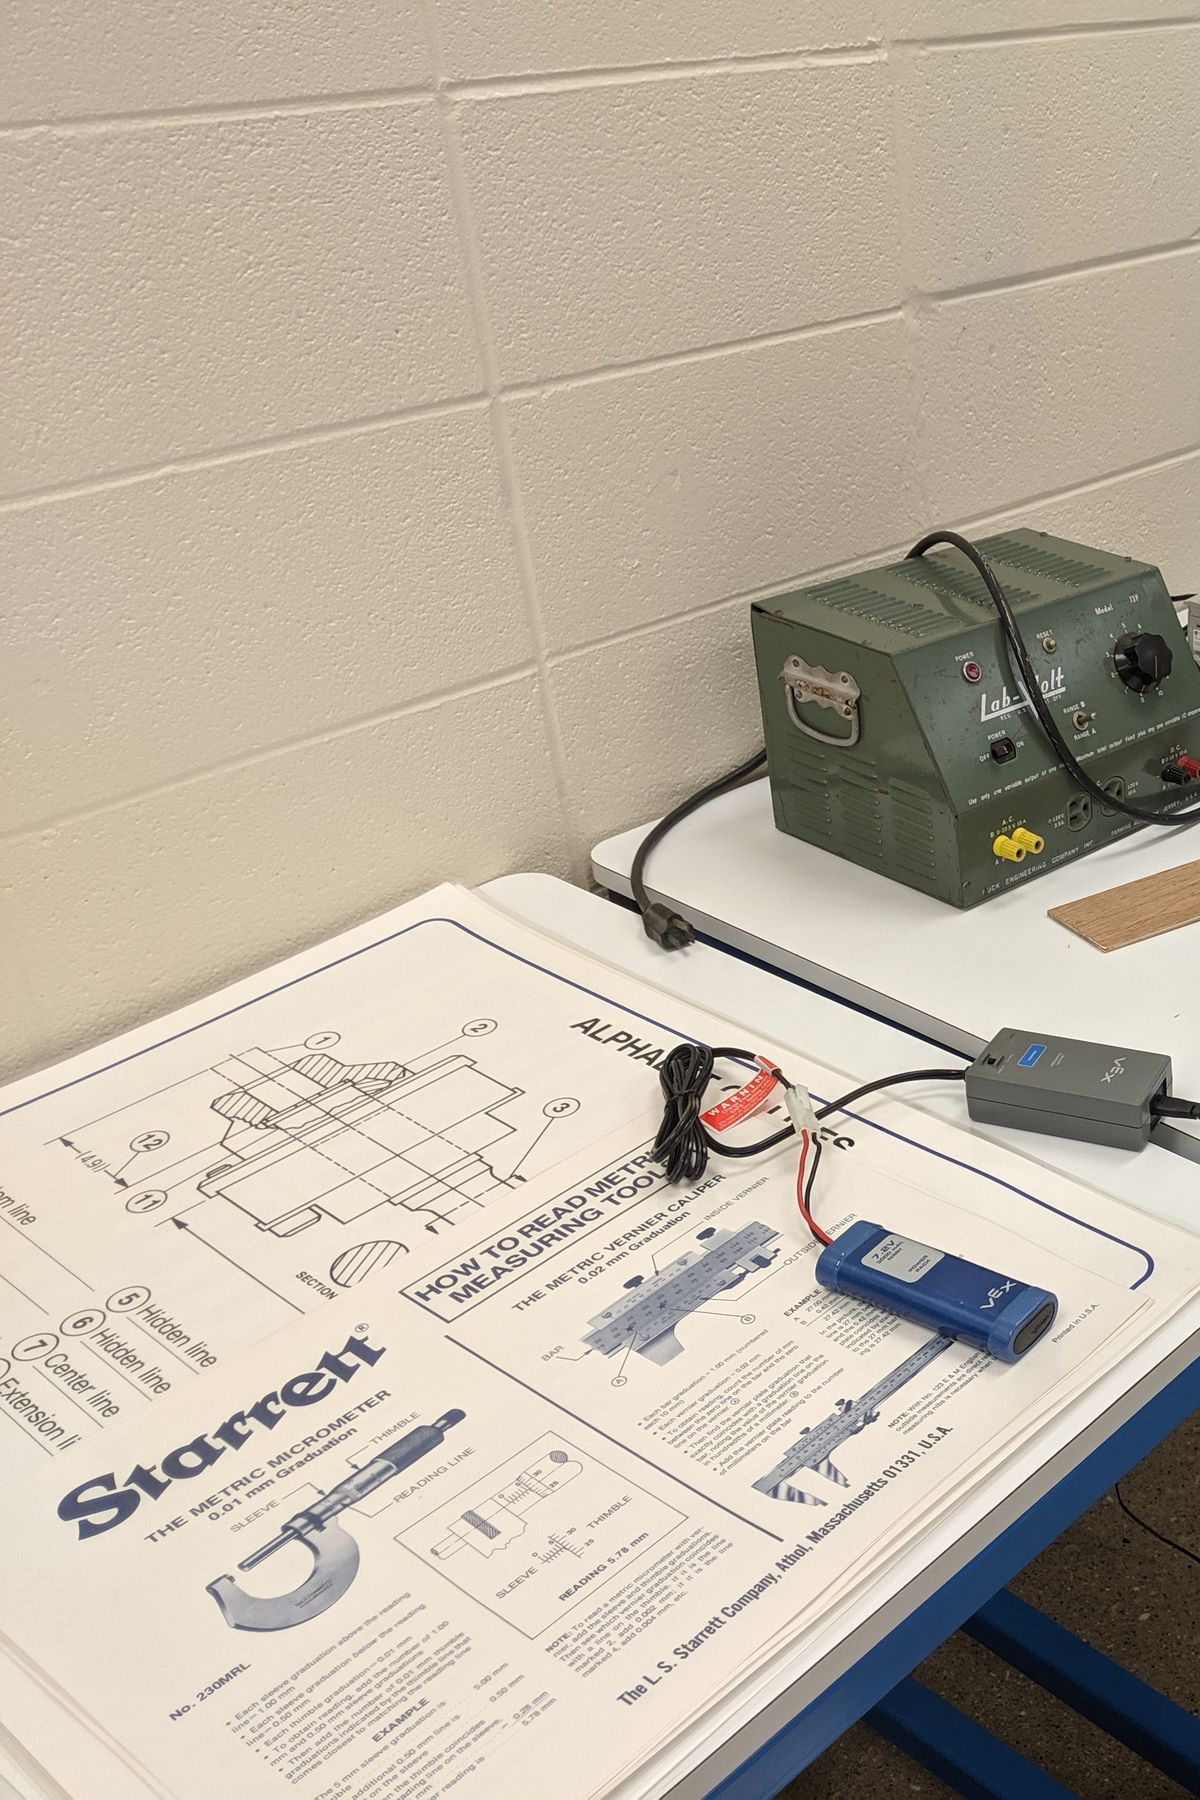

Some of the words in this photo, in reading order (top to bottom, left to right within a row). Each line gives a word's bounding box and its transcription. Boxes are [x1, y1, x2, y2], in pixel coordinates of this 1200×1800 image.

[1094, 603, 1113, 614] Model
[1036, 630, 1053, 639] RESET
[954, 651, 974, 662] POWER
[1063, 704, 1080, 714] RANGE
[987, 730, 1006, 742] POWER
[1016, 741, 1025, 749] ON
[1073, 732, 1091, 742] RANGE
[980, 753, 991, 763] OFF
[1005, 862, 1047, 885] ENGINEERING
[1052, 847, 1080, 864] COMPANY
[569, 1018, 668, 1072] ALPHA
[1100, 1057, 1128, 1085] VEX
[707, 1075, 764, 1117] WARNIN
[8, 1203, 37, 1226] line
[703, 1200, 734, 1220] INSIDE
[732, 1177, 769, 1200] VERNIER
[448, 1208, 604, 1303] MEASURING
[600, 1170, 668, 1212] TOOL
[825, 1212, 858, 1236] ERNIER
[414, 1258, 480, 1302] HOW
[480, 1237, 519, 1258] TO
[517, 1195, 587, 1238] READ
[511, 1289, 546, 1310] THE
[545, 1252, 604, 1290] METRIC
[603, 1212, 668, 1251] VERNIER
[667, 1174, 726, 1212] CALIPER
[577, 1266, 606, 1283] 0.02
[605, 1251, 629, 1266] mm
[628, 1211, 690, 1250] Graduation
[872, 1240, 895, 1260] 7.2V
[908, 1255, 929, 1273] POWER
[915, 1260, 932, 1273] PACK
[296, 1271, 338, 1300] SECTION
[783, 1288, 822, 1316] EXAMPLE
[980, 1280, 1018, 1311] VEX
[136, 1304, 191, 1349] Hidden
[192, 1341, 218, 1368] line
[1051, 1324, 1075, 1343] Printed
[1071, 1317, 1080, 1325] in
[90, 1328, 144, 1374] Hidden
[145, 1366, 172, 1395] line
[541, 1345, 565, 1362] BAR
[44, 1354, 96, 1395] Center
[86, 1391, 120, 1418] line
[0, 1377, 65, 1442] Extension
[57, 1336, 388, 1542] Starrett
[370, 1411, 420, 1444] THIMBLE
[143, 1515, 188, 1542] THE
[188, 1468, 265, 1516] METRIC
[266, 1390, 391, 1468] MICROMETER
[881, 1450, 926, 1480] 01331,
[917, 1426, 953, 1448] U.S.A.
[208, 1498, 242, 1520] 0.01
[245, 1479, 275, 1498] mm
[276, 1428, 357, 1478] Graduation
[393, 1466, 448, 1502] READING
[447, 1447, 475, 1466] LINE
[230, 1499, 280, 1532] SLEEVE
[586, 1495, 632, 1528] THIMBLE
[774, 1543, 813, 1576] Athol,
[805, 1478, 888, 1544] Massachusetts
[495, 1566, 538, 1599] SLEEVE
[558, 1564, 607, 1601] READING
[607, 1547, 629, 1564] 5.78
[630, 1532, 648, 1547] mm
[545, 1631, 573, 1653] NOTE:
[616, 1684, 647, 1705] The
[642, 1675, 662, 1685] L.
[657, 1661, 677, 1673] S.
[673, 1616, 726, 1659] Starrett
[720, 1573, 782, 1617] Company,
[169, 1704, 195, 1721] No.
[196, 1663, 251, 1701] 230MRL
[371, 1697, 430, 1742] EXAMPLE
